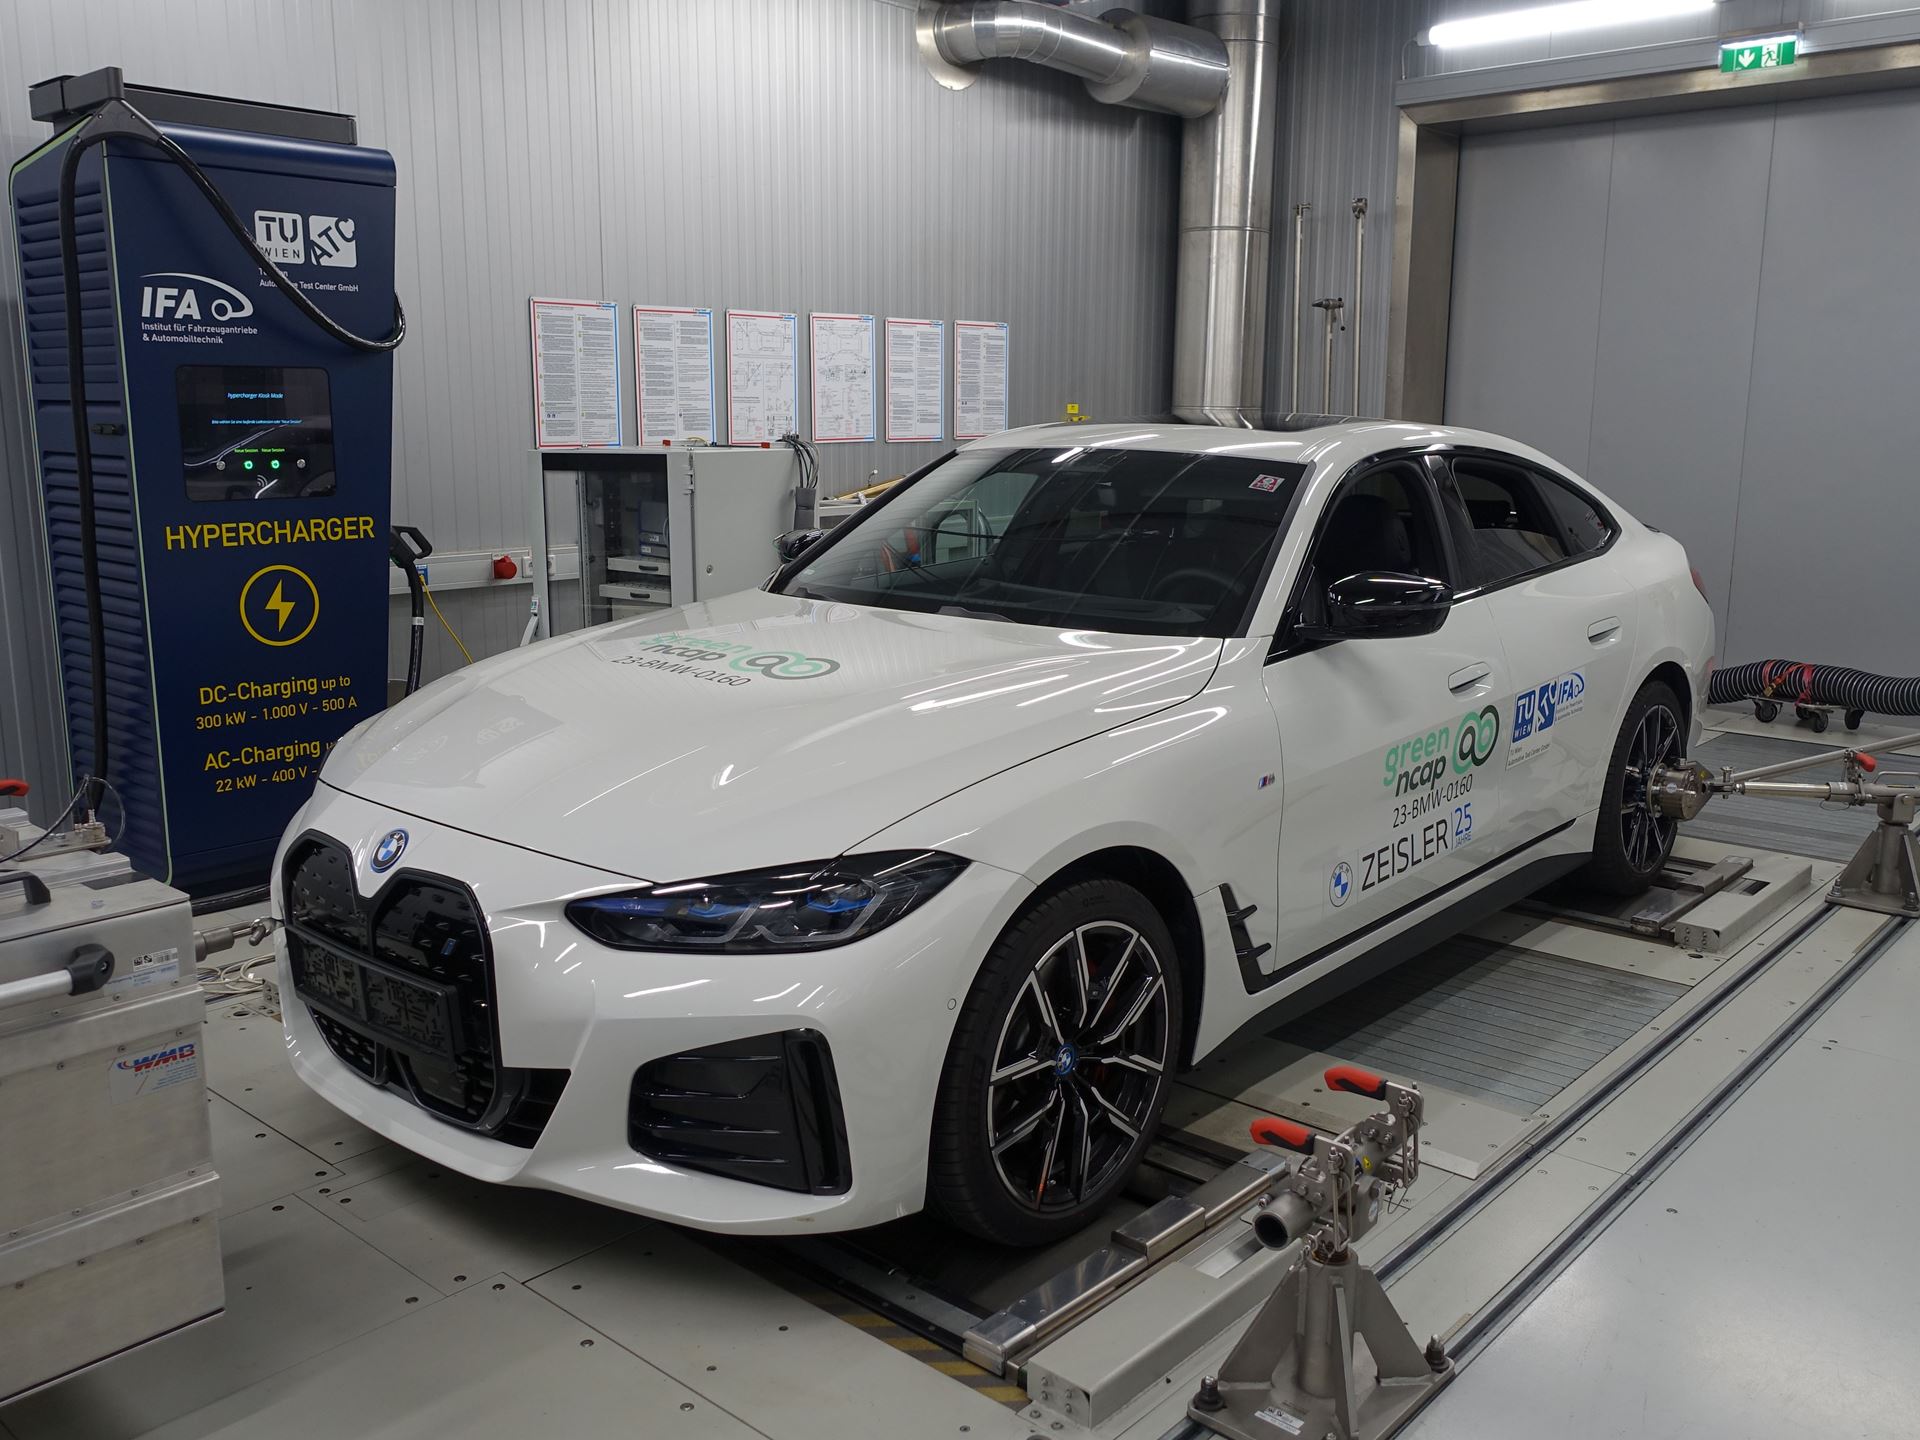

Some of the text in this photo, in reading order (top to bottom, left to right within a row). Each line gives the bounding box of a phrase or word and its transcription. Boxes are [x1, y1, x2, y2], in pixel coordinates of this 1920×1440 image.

[258, 215, 298, 243] TU
[260, 247, 300, 259] WIEN
[299, 281, 314, 290] Test
[314, 282, 337, 291] Center
[338, 283, 359, 292] GmbH
[141, 286, 202, 320] IFA
[141, 322, 258, 336] Institut für Fahrzeugantriebe
[142, 333, 224, 344] & Automobiltechnik
[165, 516, 375, 550] HYPERCHARGER
[639, 634, 752, 653] green
[641, 644, 727, 662] ncap
[611, 655, 751, 687] 23-BMW-0160
[199, 675, 351, 705] DC-Charging up to
[1557, 678, 1574, 706] IFA
[195, 714, 222, 730] 300
[225, 711, 247, 726] kW
[262, 704, 297, 721] 1.000
[298, 702, 308, 715] V
[322, 697, 345, 712] 500
[347, 696, 358, 708] A
[1518, 694, 1535, 723] TU
[1514, 723, 1532, 739] WIEN
[204, 739, 321, 772] AC-Charging
[1383, 726, 1450, 787] green
[215, 779, 233, 793] 22
[236, 775, 257, 790] kW
[271, 768, 296, 783] 400
[298, 765, 308, 778] V
[1395, 755, 1447, 797] ncap
[1393, 773, 1473, 828] 23-BMW-0160
[1454, 802, 1472, 837] 25
[1361, 818, 1448, 892] ZEISLER
[133, 1043, 195, 1073] WMB
